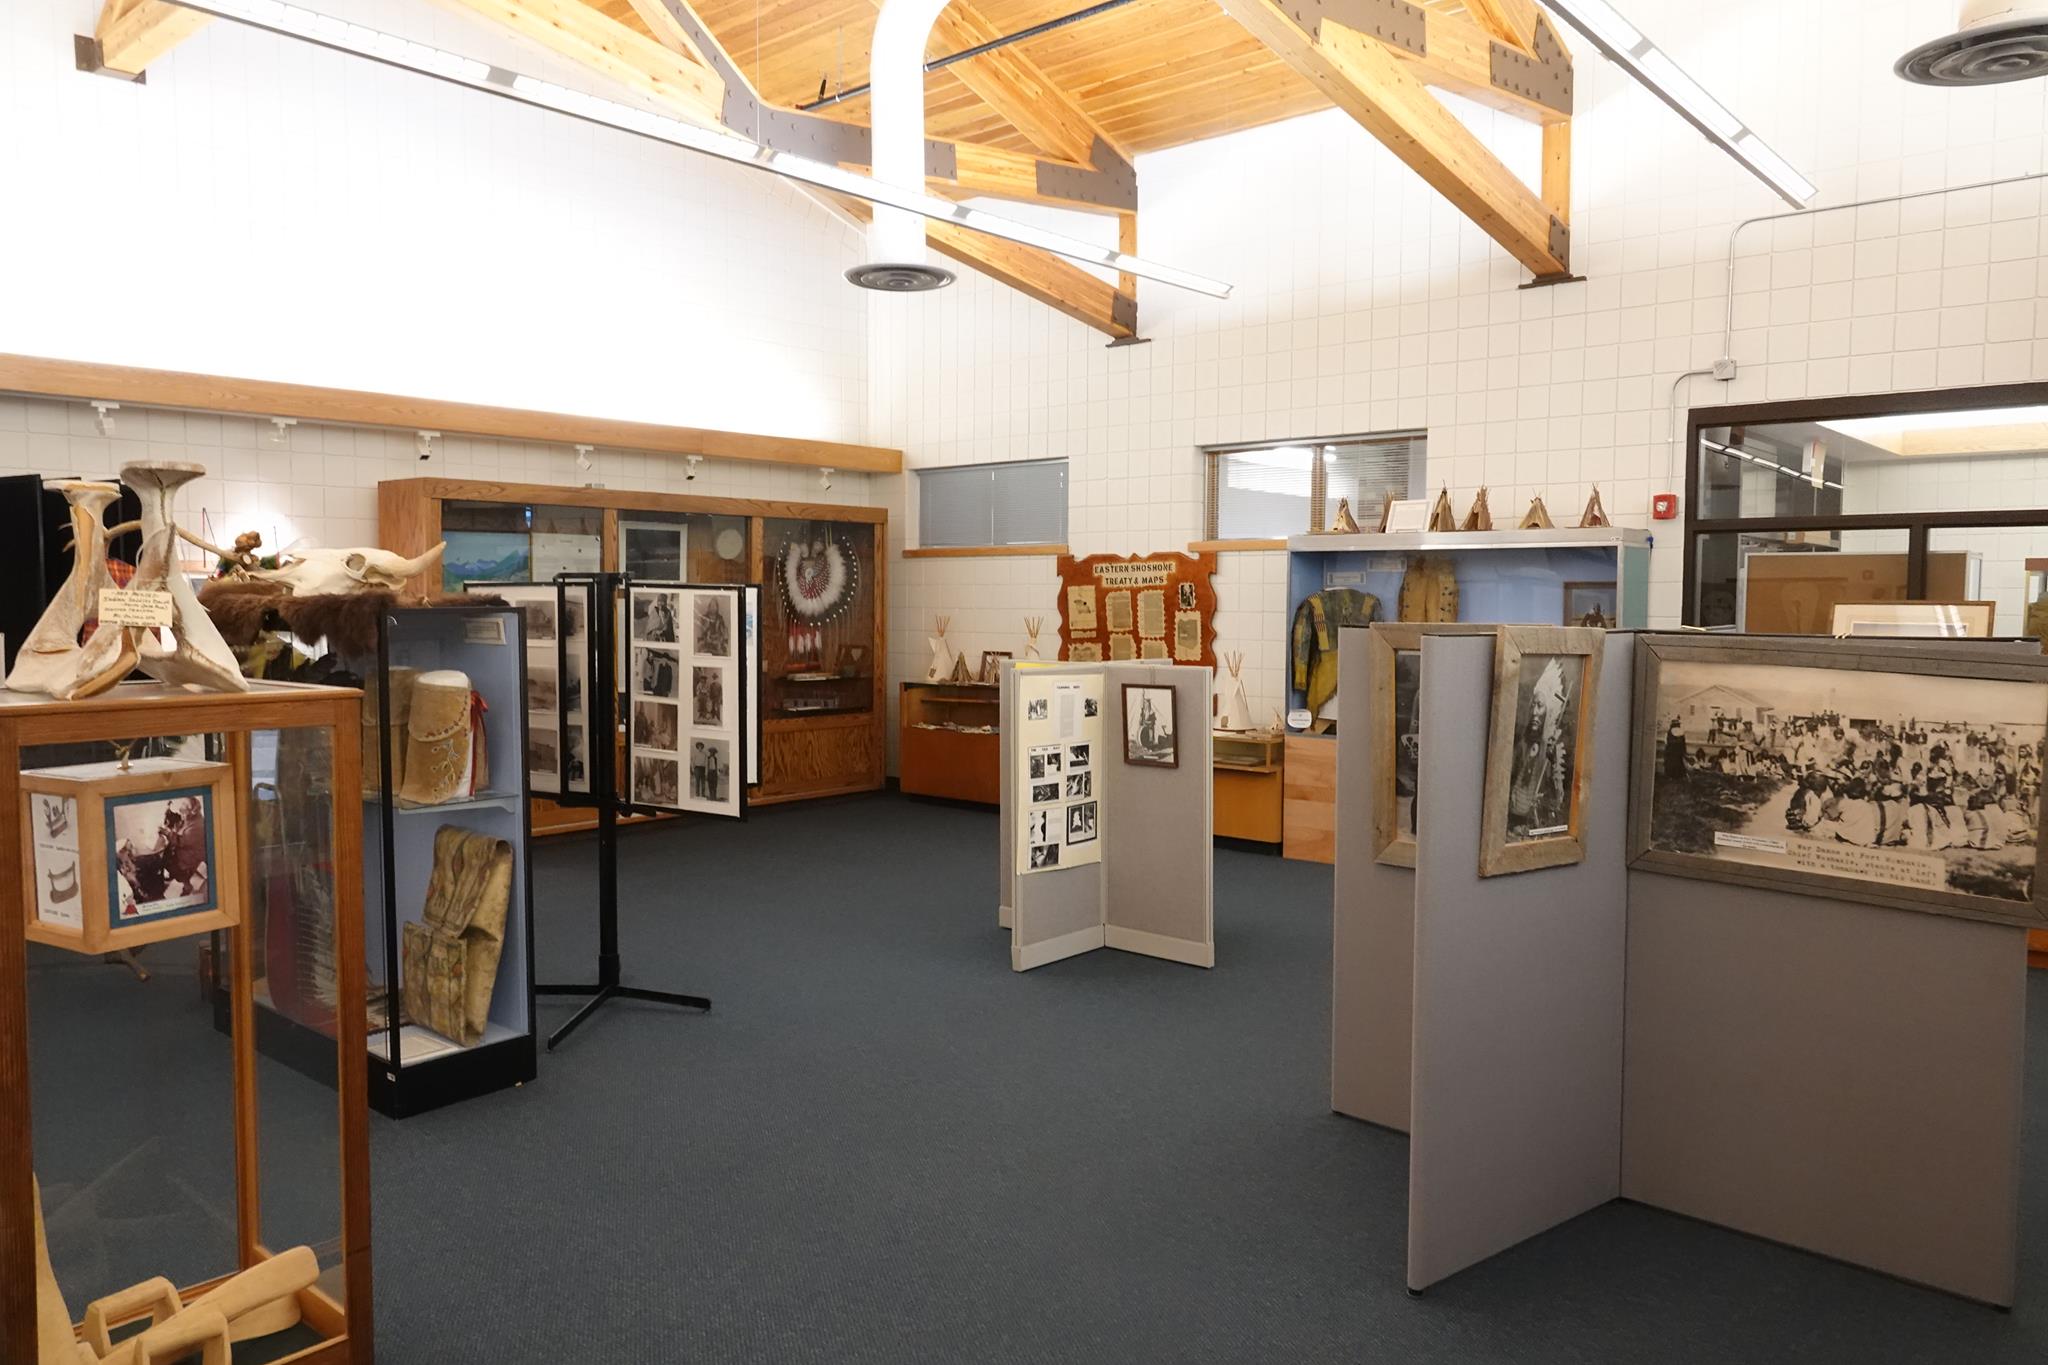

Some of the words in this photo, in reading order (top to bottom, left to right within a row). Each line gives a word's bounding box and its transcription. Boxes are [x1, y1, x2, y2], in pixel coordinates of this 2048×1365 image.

[1094, 564, 1129, 574] EASTERN
[1130, 563, 1173, 572] SHOSHONE
[1105, 577, 1133, 585] TREATY
[1142, 576, 1164, 584] MAPS
